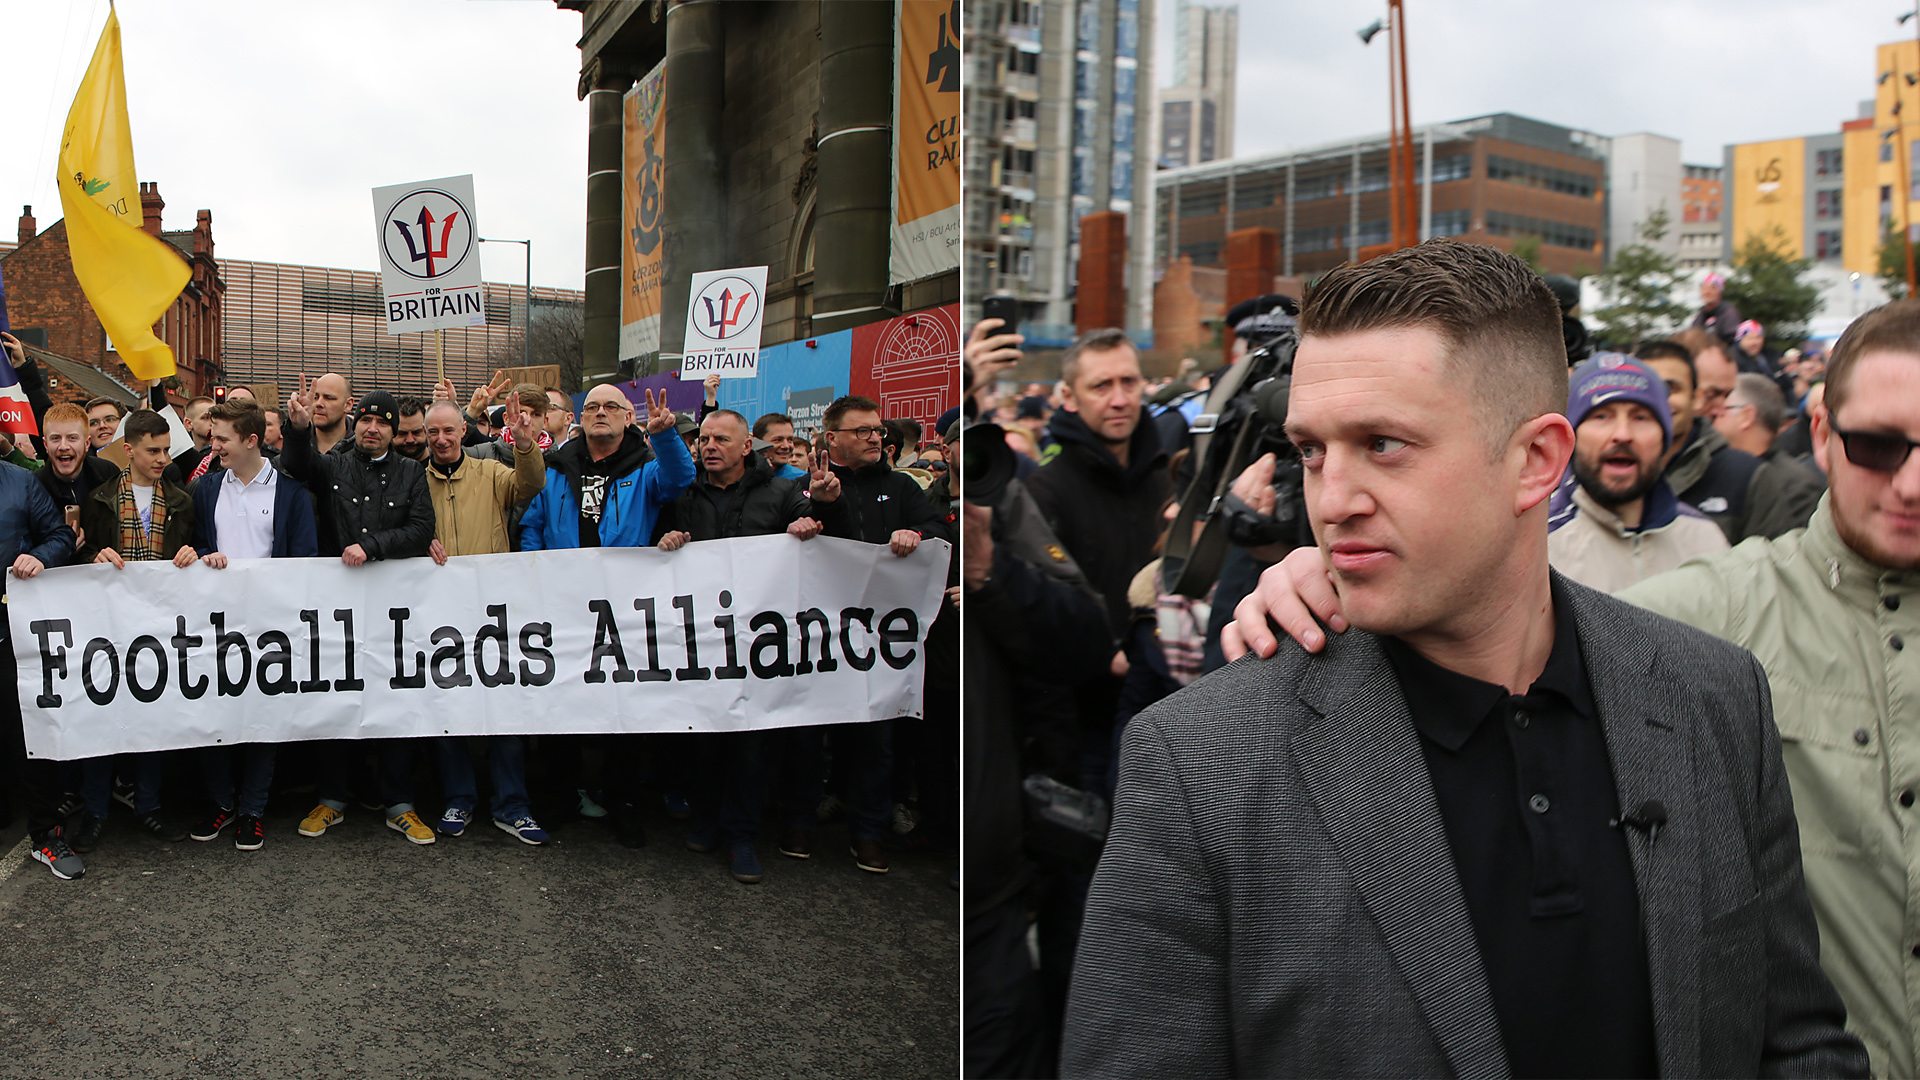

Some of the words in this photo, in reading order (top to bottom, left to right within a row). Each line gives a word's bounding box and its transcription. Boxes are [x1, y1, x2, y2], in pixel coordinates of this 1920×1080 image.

[926, 115, 960, 144] CU
[927, 141, 960, 170] RAI
[929, 225, 944, 238] BCU
[945, 222, 957, 232] Art
[425, 287, 441, 296] FOR
[388, 292, 481, 322] BRITAIN
[684, 352, 755, 371] BRITAIN
[0, 410, 22, 423] ON
[29, 608, 365, 709] Football
[388, 603, 556, 690] Lads
[583, 589, 919, 684] Alliance
